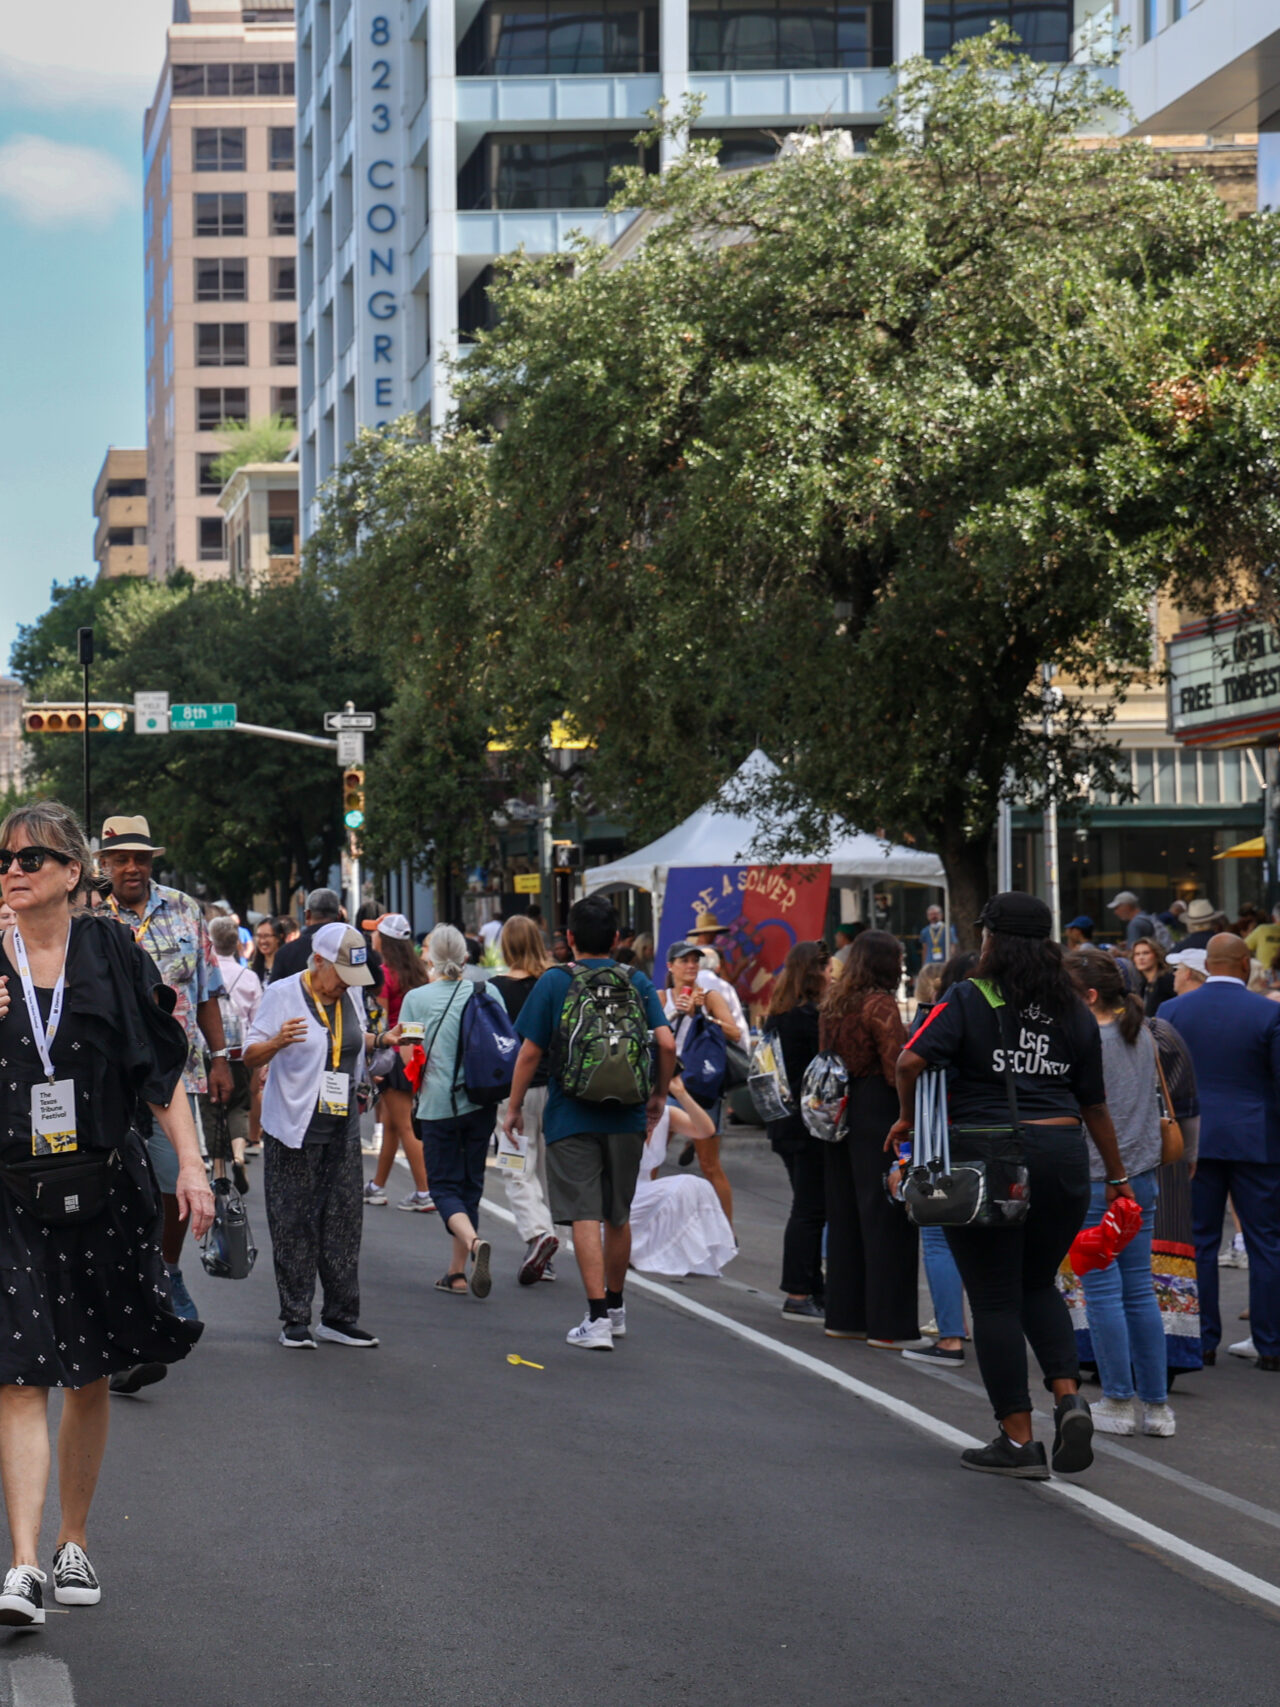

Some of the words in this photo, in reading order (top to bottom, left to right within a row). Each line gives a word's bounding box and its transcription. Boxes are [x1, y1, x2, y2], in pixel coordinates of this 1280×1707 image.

[370, 15, 391, 134] 823
[366, 159, 398, 430] CONGRE
[183, 706, 207, 720] 8th
[1180, 682, 1213, 714] FREE
[690, 887, 719, 915] BE
[721, 873, 734, 897] A
[736, 869, 797, 913] SOLVER
[41, 1111, 67, 1120] Festival
